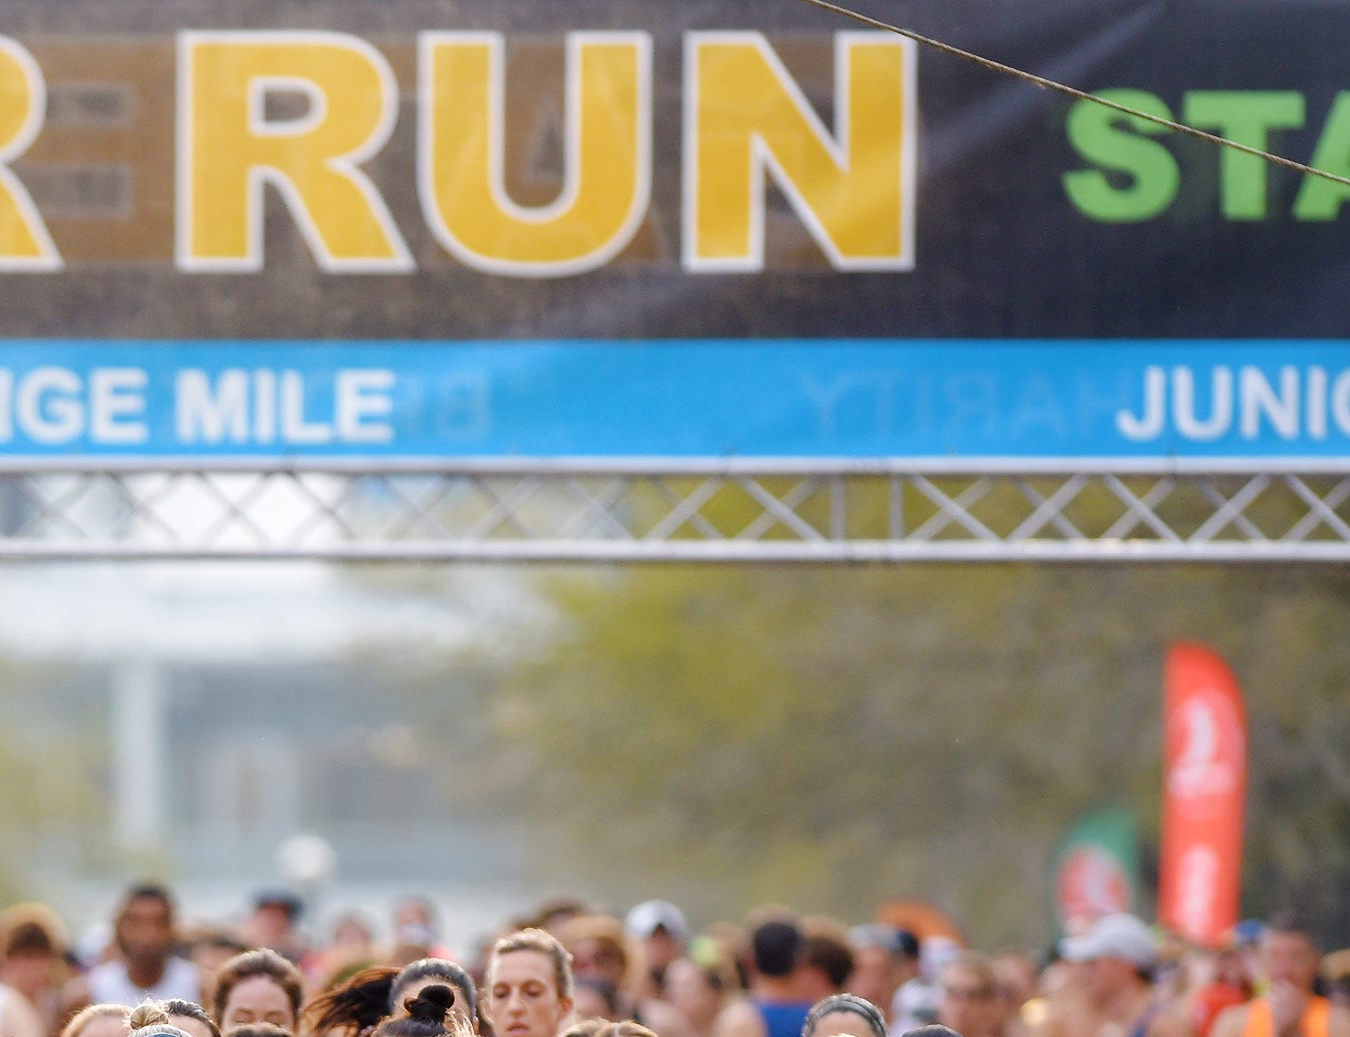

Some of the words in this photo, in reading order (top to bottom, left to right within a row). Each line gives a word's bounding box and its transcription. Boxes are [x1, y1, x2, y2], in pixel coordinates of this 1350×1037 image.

[174, 30, 918, 278] RUN
[176, 367, 395, 446] MILE
[1114, 363, 1350, 443] JUNI
